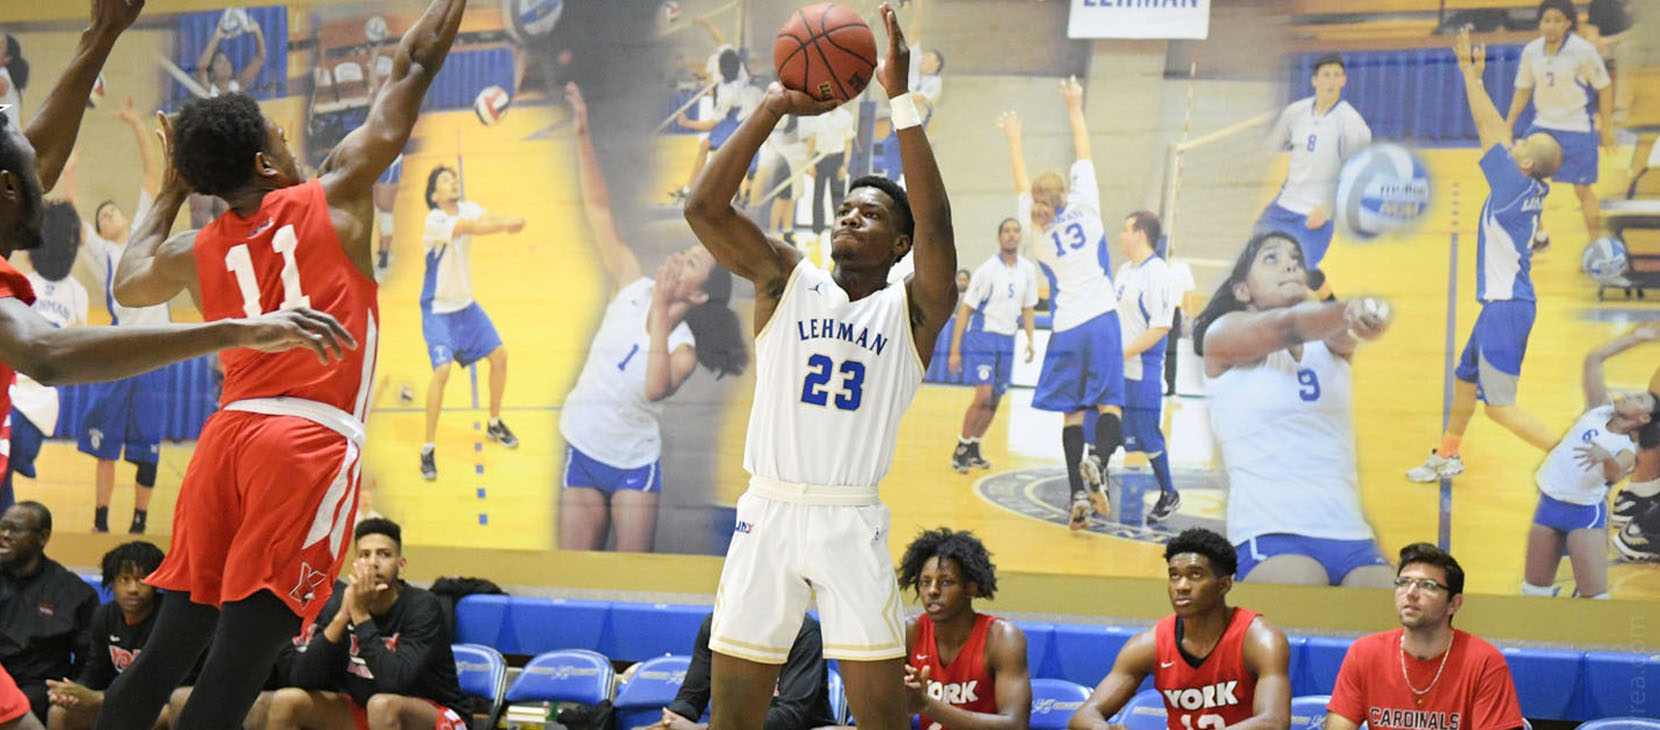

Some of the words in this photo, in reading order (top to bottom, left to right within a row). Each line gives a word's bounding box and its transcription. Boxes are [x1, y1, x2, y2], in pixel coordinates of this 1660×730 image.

[1051, 222, 1086, 257] 13
[225, 224, 311, 319] 11
[798, 318, 888, 356] LEHMAN
[617, 343, 639, 371] 1
[800, 353, 866, 412] 23
[1297, 368, 1321, 402] 9
[926, 679, 979, 704] ORK
[1163, 680, 1239, 711] YORK
[1369, 706, 1461, 730] CARDINALS
